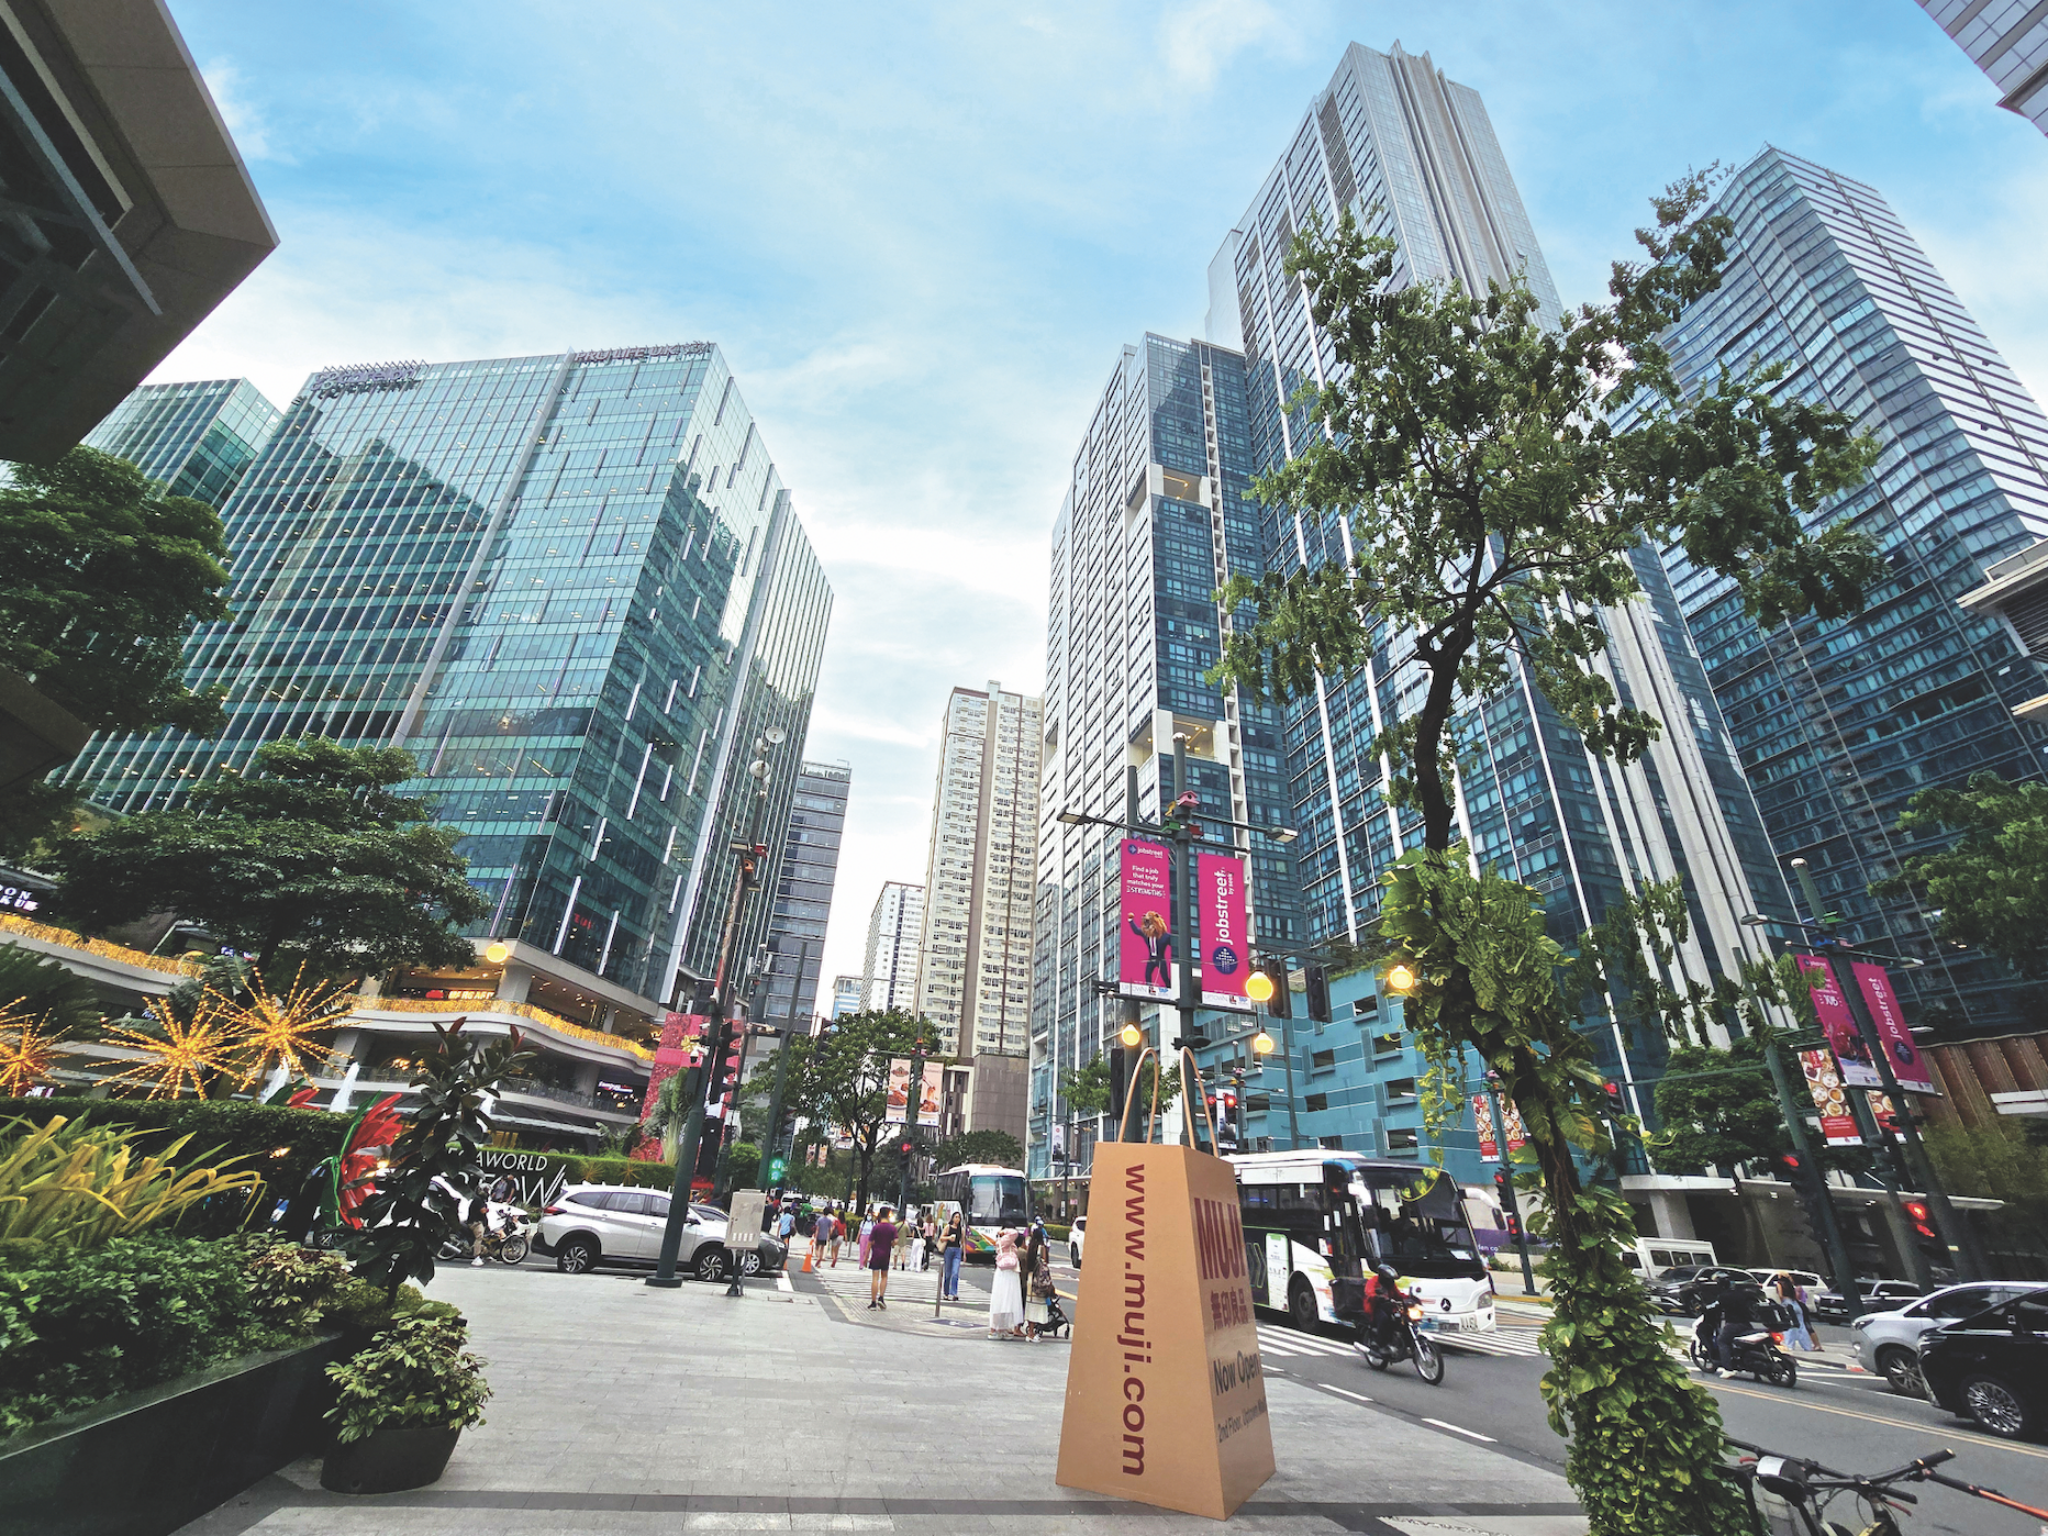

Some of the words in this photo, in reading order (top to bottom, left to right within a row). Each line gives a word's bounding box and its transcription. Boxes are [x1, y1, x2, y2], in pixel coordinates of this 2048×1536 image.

[1214, 870, 1234, 946] jobstreet
[1121, 984, 1148, 994] UPOWN
[1868, 977, 1904, 1040] jobstreet
[1194, 1197, 1246, 1280] MUJI
[1117, 1163, 1152, 1477] www.muji.com
[1213, 1359, 1237, 1396] Now
[1237, 1350, 1261, 1390] Open
